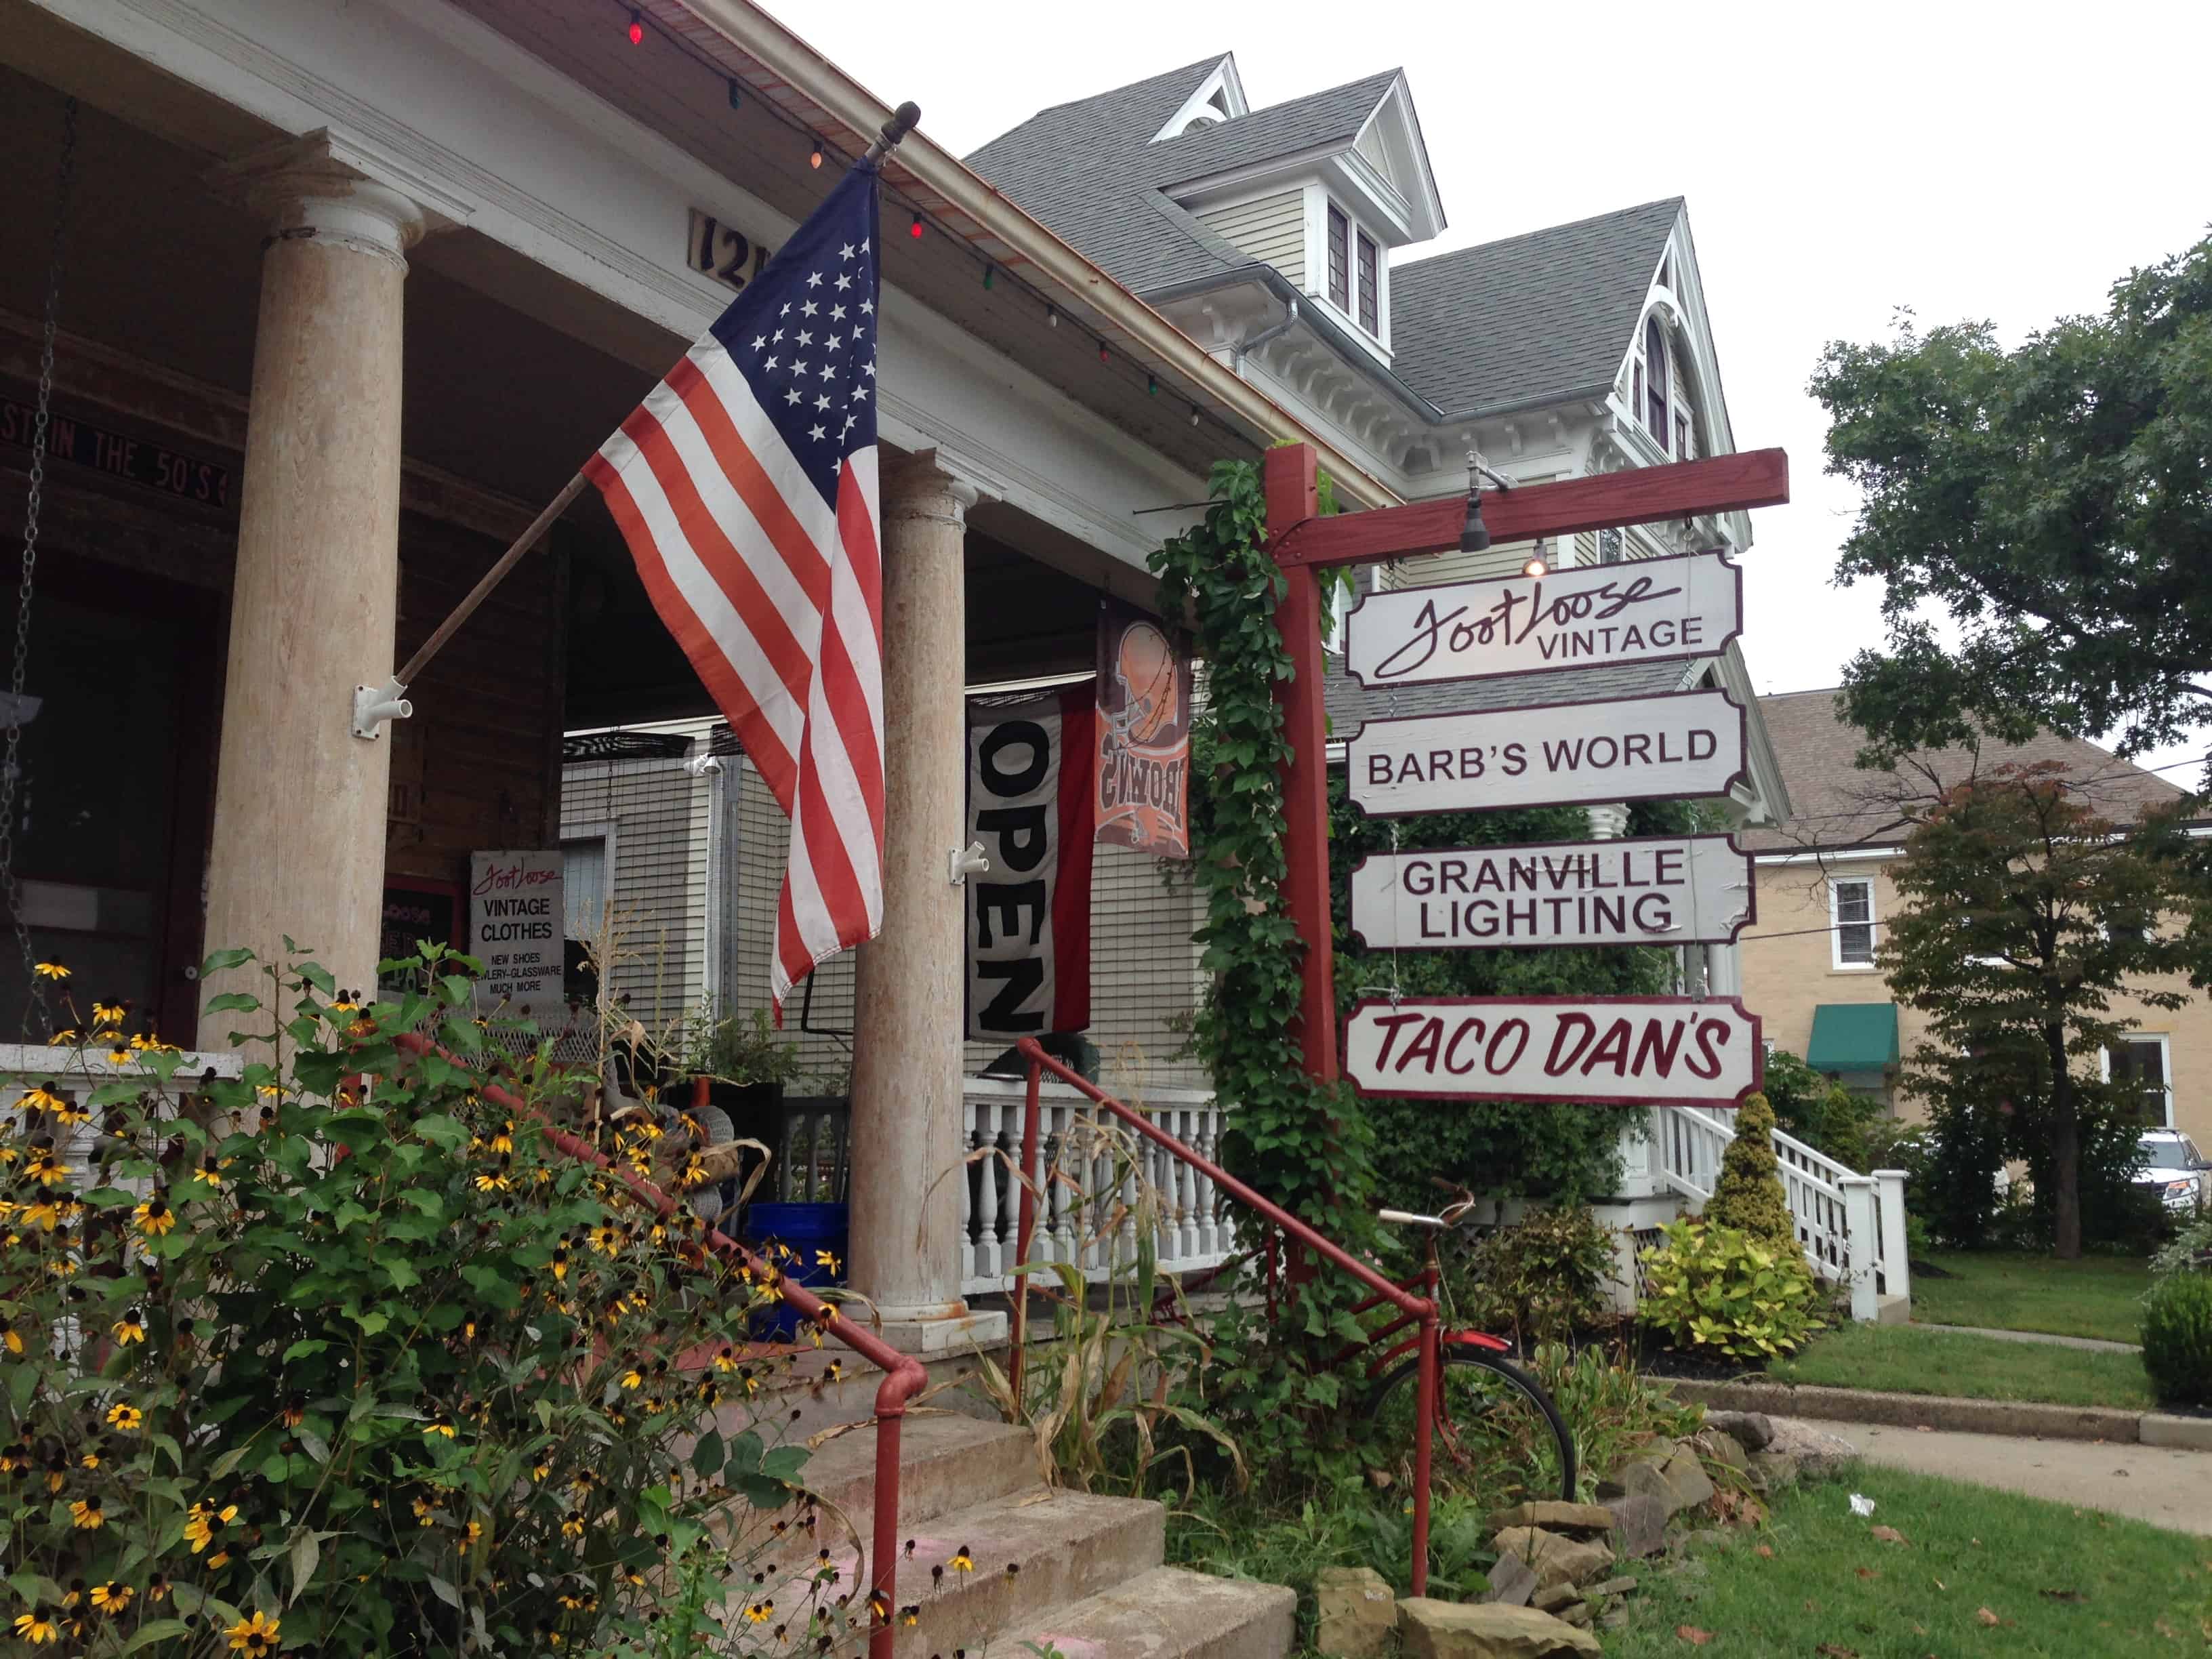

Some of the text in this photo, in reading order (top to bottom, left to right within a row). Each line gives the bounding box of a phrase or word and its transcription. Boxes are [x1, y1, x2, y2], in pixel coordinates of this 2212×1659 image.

[50, 420, 77, 459] IN
[94, 432, 139, 478] THE
[154, 450, 212, 501] 50'S
[1537, 616, 1703, 660] VINTAGE
[1368, 729, 1718, 785] BARB'S WORLD
[976, 720, 1051, 1033] OPEN
[1403, 848, 1685, 895] GRANVILLE
[484, 899, 550, 917] VINTAGE
[1420, 892, 1673, 939] LIGHTING
[481, 922, 552, 942] CLOTHES
[476, 966, 562, 981] EWLERY-GLASSWARE
[491, 953, 541, 966] NEW SHOES
[490, 981, 541, 995] MUCH MORE
[1373, 1011, 1732, 1080] TACO DAN'S
